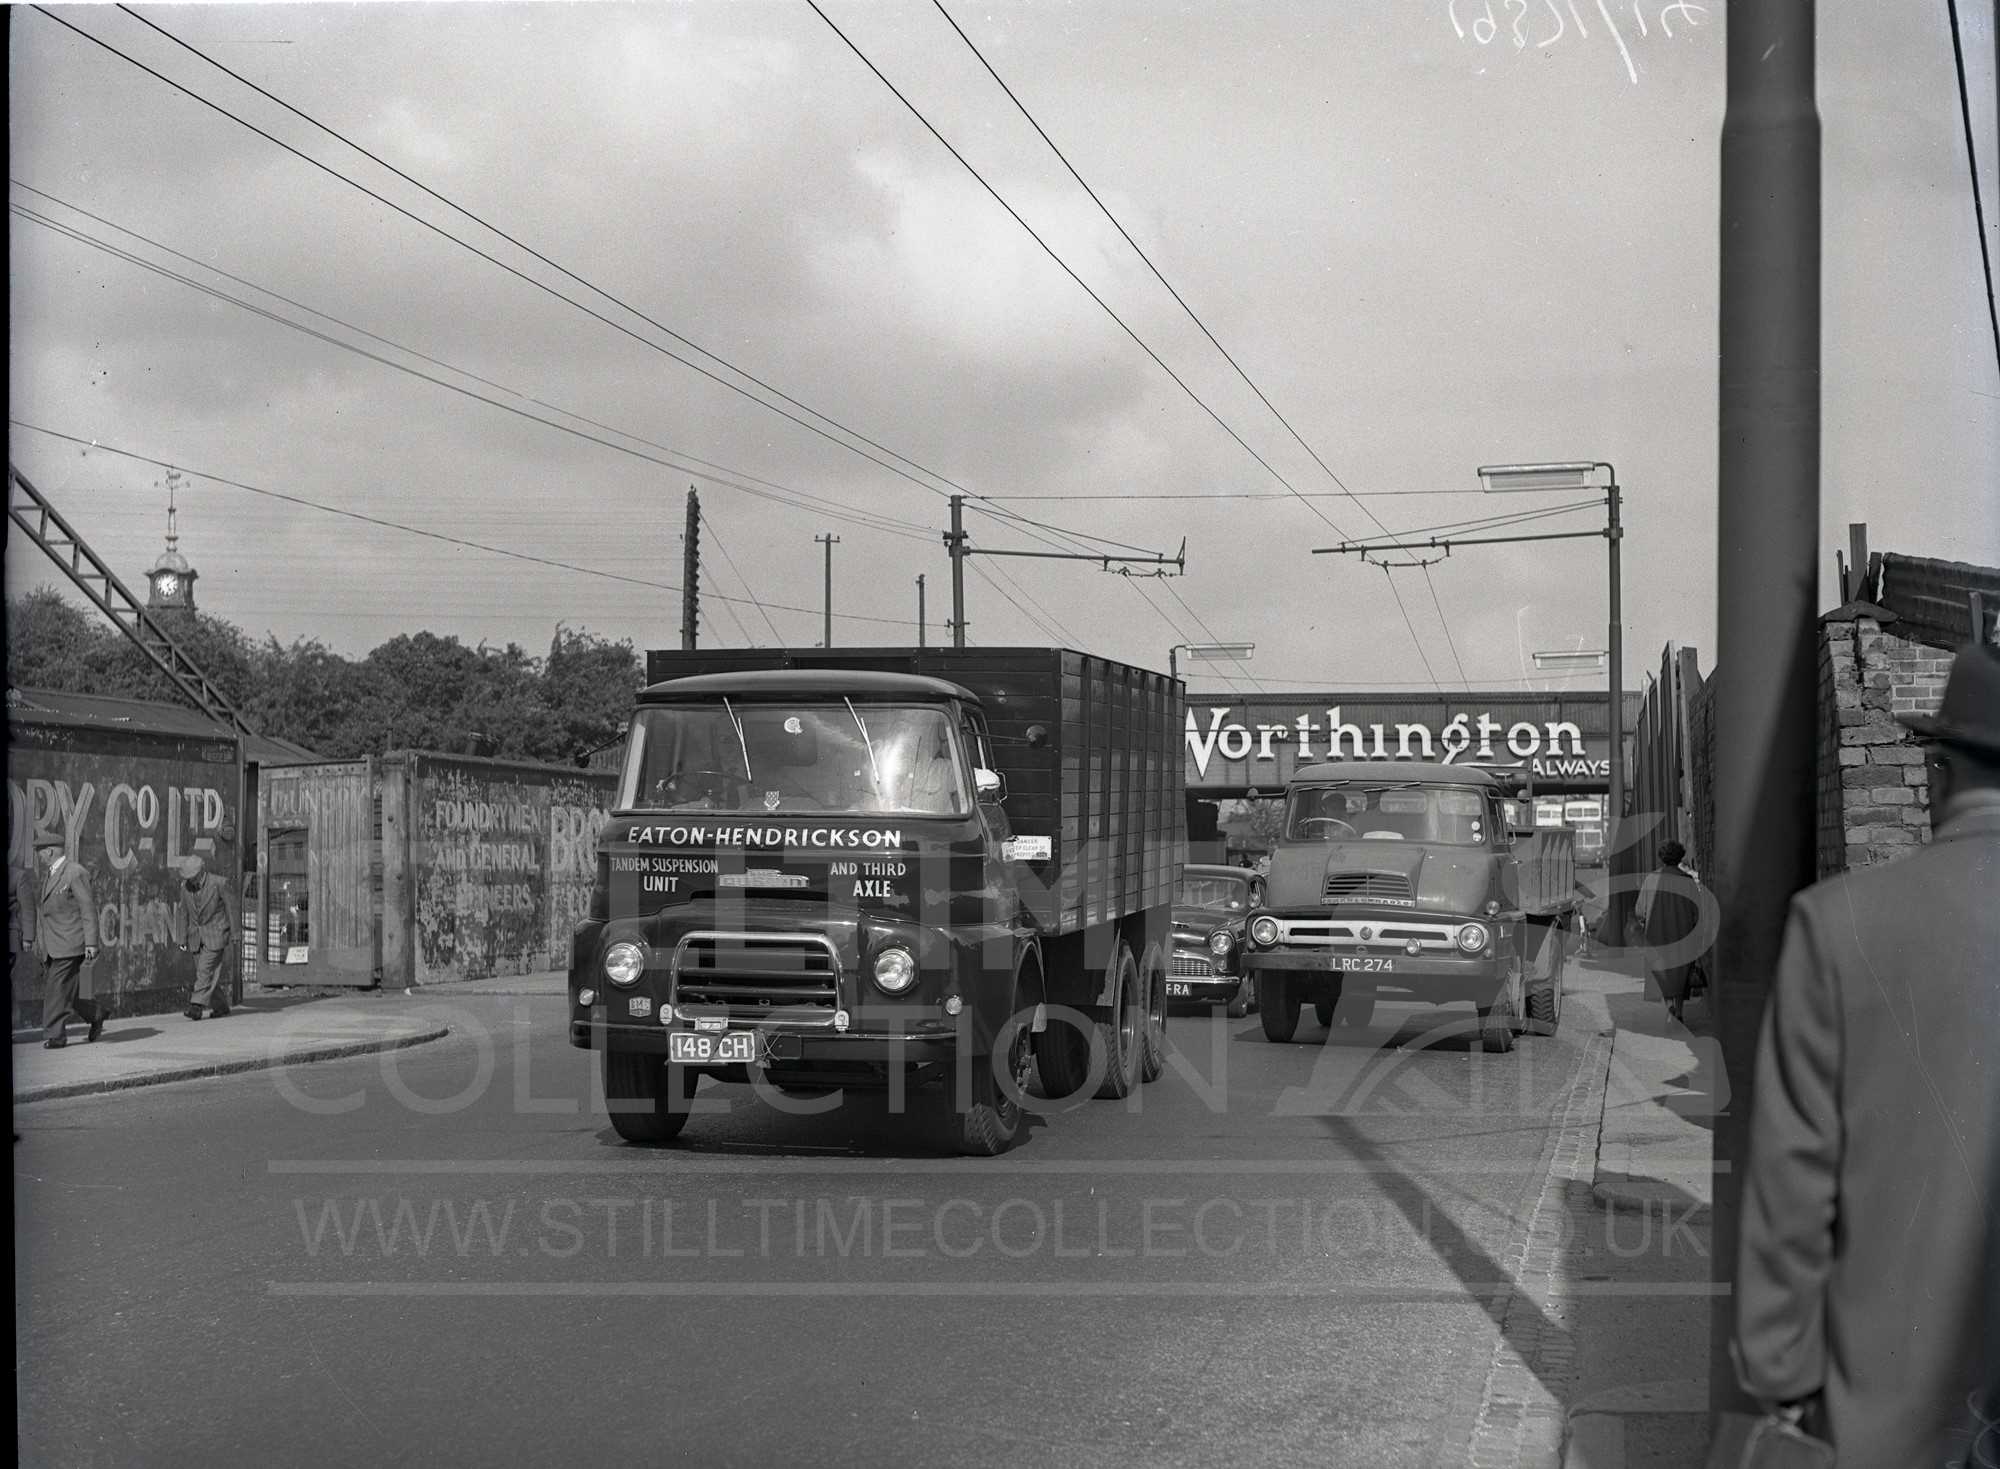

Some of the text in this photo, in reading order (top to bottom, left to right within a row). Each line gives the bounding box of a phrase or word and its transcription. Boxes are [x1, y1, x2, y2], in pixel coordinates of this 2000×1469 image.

[1185, 706, 1586, 778] Worthington
[1532, 759, 1610, 776] ALWAYS
[627, 826, 901, 849] EATON-HENDRICKSON
[470, 843, 541, 873] GENERAL
[611, 857, 719, 874] TANDEM SUSPENSION
[830, 862, 907, 877] AND THIRD
[643, 876, 679, 892] UNIT
[853, 879, 891, 898] AXLE
[432, 883, 534, 913] EINEERS
[1332, 958, 1393, 972] LRC 274
[677, 1037, 748, 1058] 148 CH
